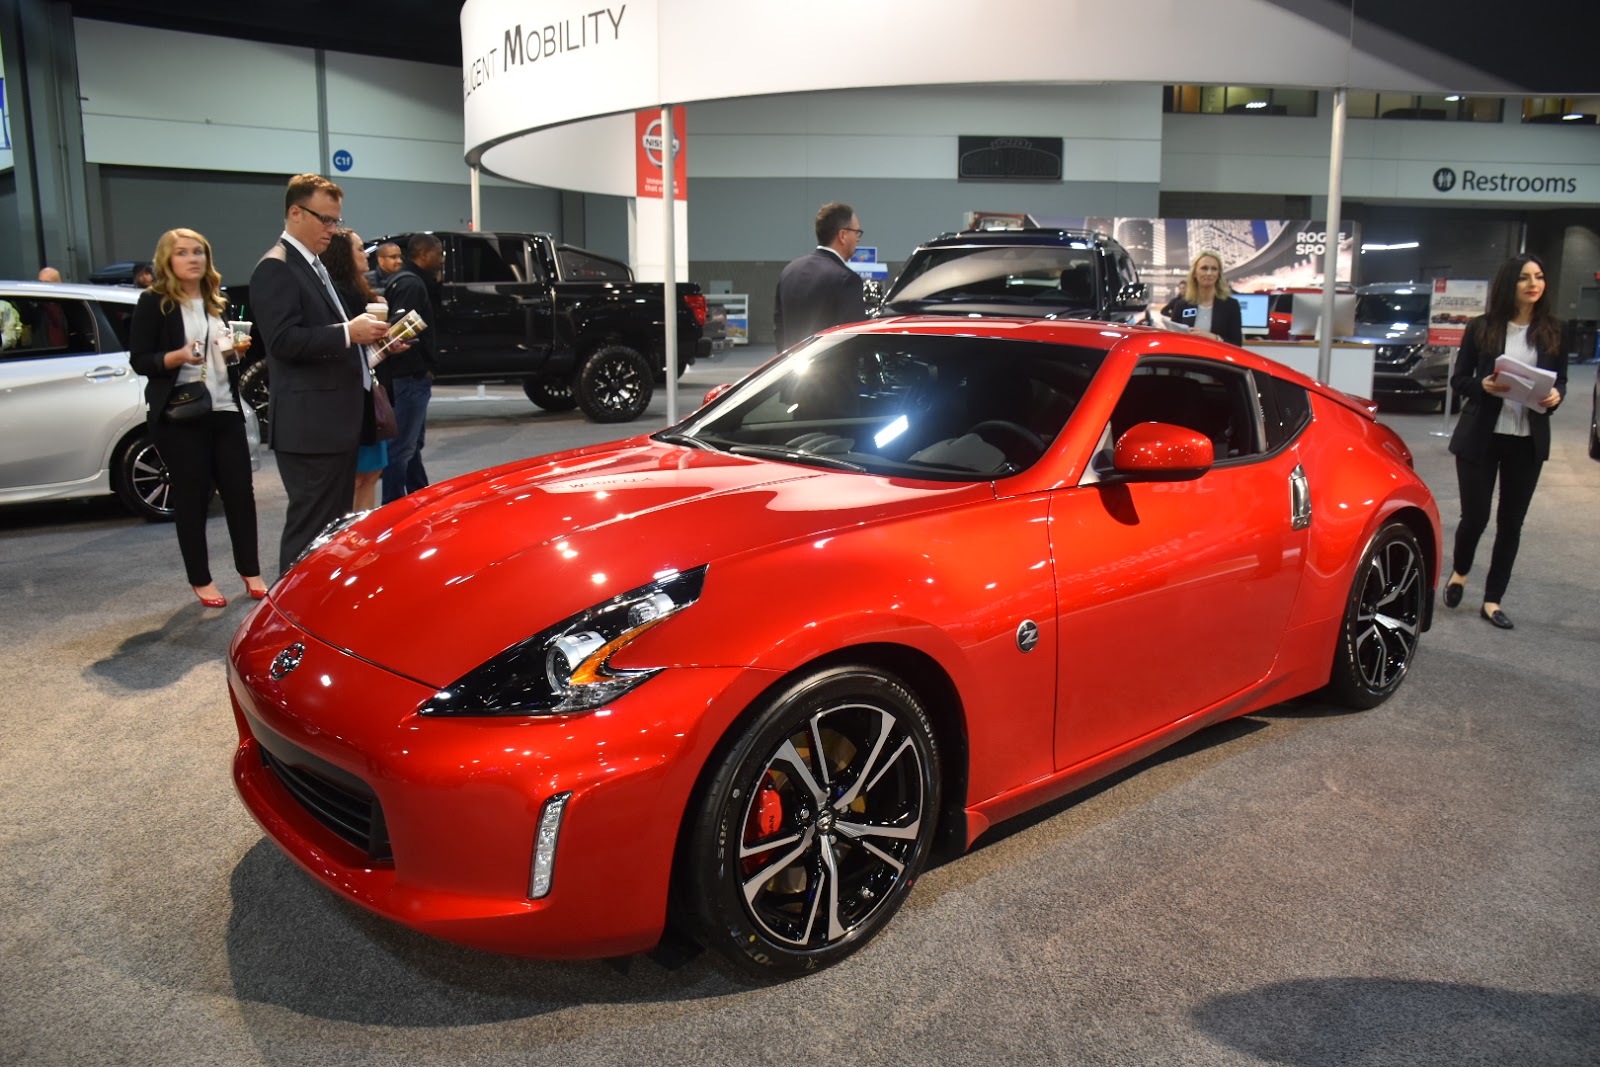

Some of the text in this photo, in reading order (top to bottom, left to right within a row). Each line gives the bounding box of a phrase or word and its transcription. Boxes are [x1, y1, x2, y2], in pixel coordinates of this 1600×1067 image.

[504, 4, 626, 72] MOBILITY
[1462, 170, 1577, 193] Restrooms
[1296, 231, 1346, 243] ROGE
[1295, 243, 1327, 256] SPO
